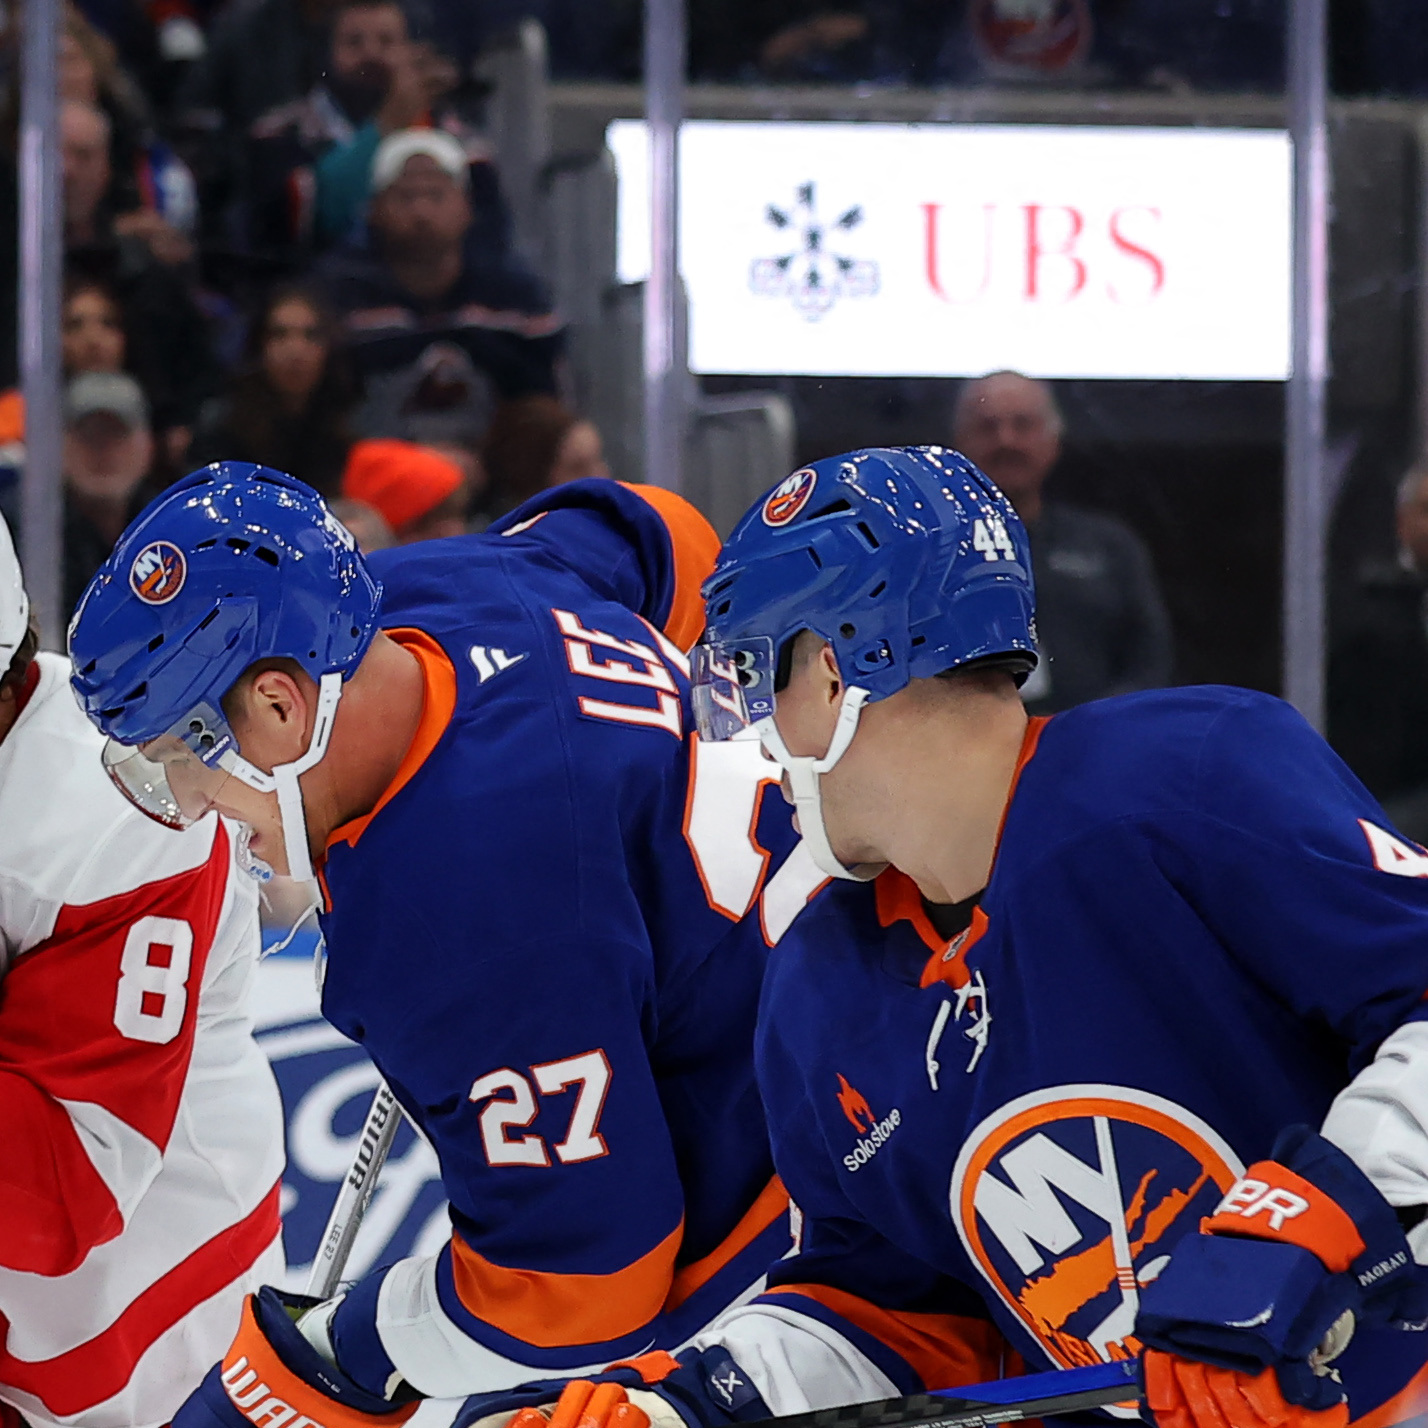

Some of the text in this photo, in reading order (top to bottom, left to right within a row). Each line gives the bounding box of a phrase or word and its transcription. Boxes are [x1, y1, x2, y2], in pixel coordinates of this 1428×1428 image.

[918, 202, 1167, 306] UBS
[972, 518, 1017, 562] 44
[550, 608, 683, 741] LEE
[113, 914, 194, 1045] 8
[467, 1046, 614, 1168] 27
[323, 1223, 343, 1262] LEE 27
